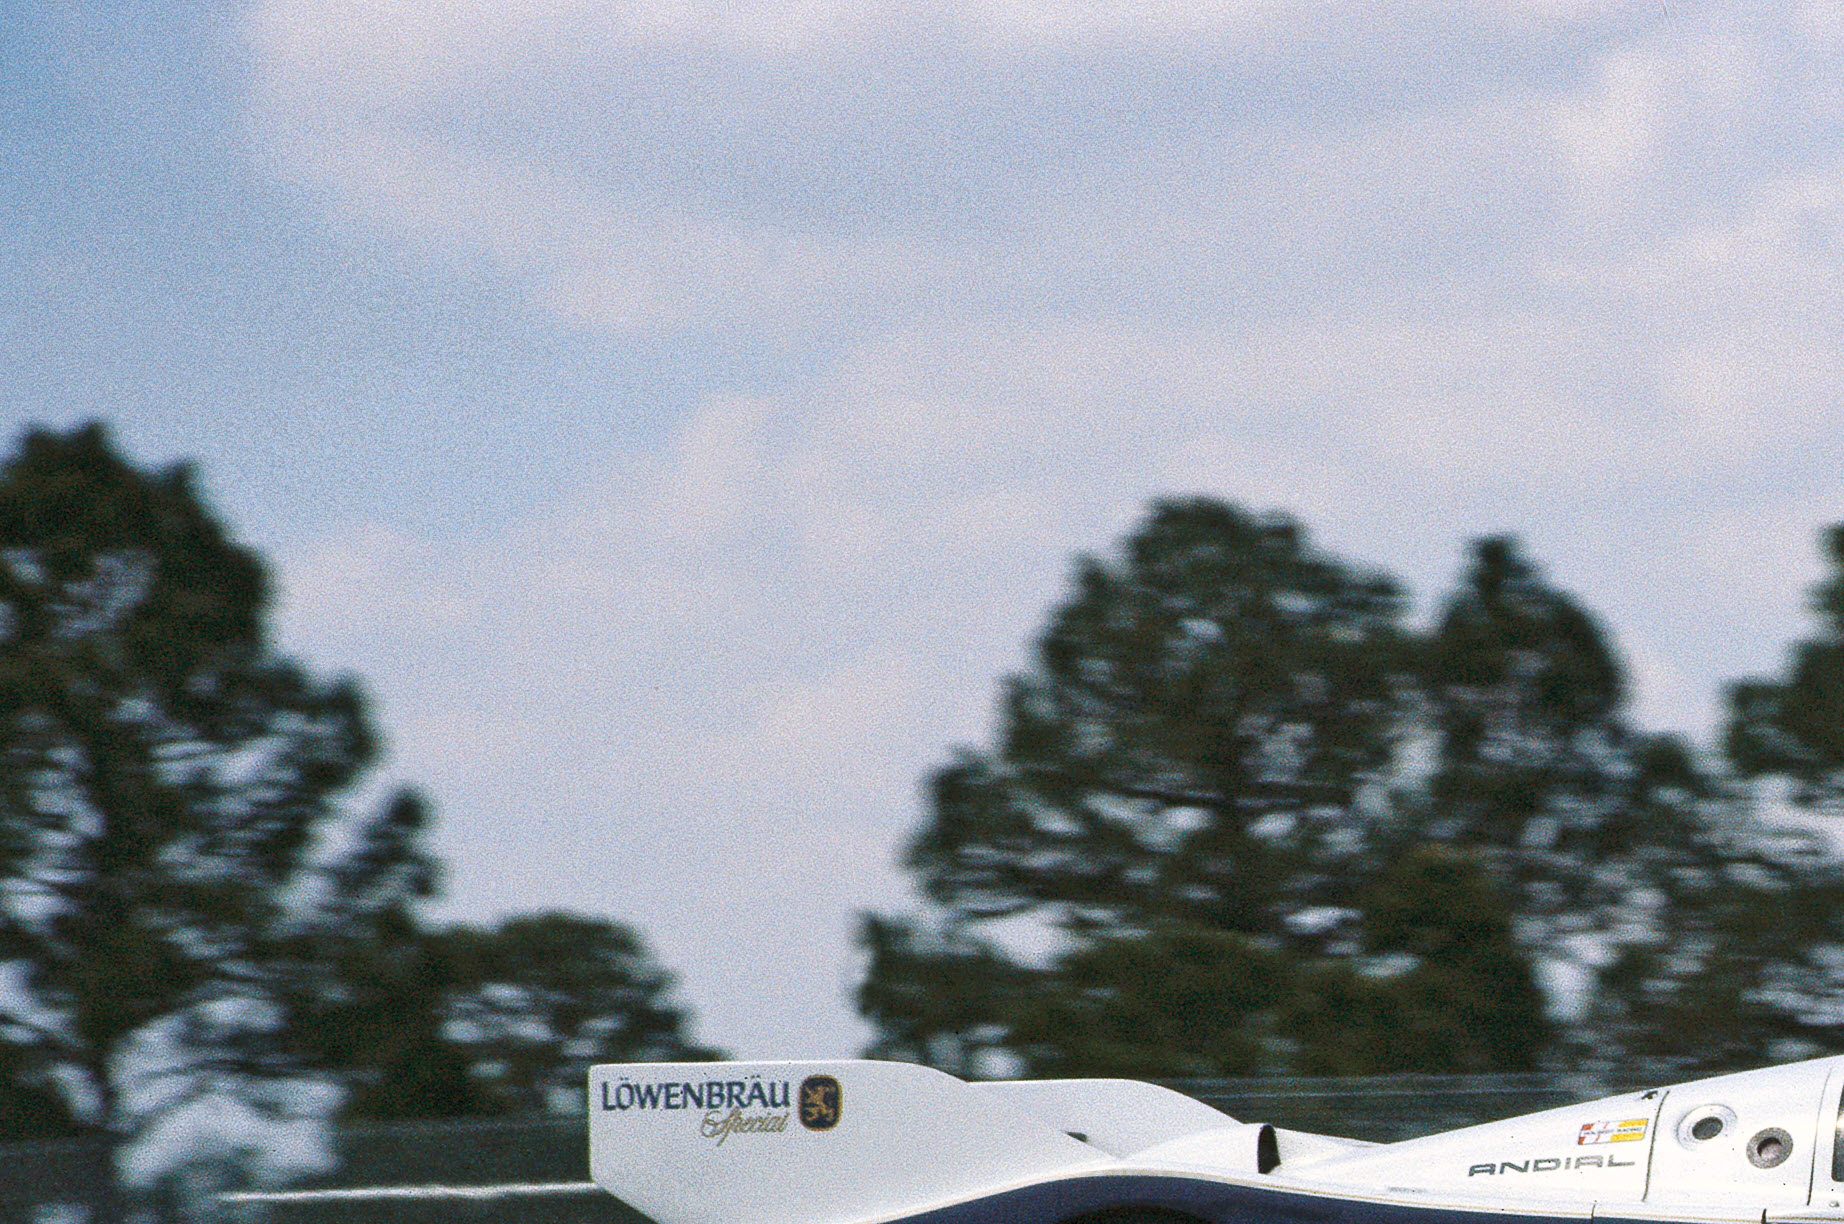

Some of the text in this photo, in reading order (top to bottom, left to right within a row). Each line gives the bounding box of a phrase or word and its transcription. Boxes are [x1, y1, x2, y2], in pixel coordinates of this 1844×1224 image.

[601, 1074, 790, 1111] LÖWENBRÄU
[702, 1106, 790, 1147] Special
[1468, 1154, 1635, 1177] ANDIAL
